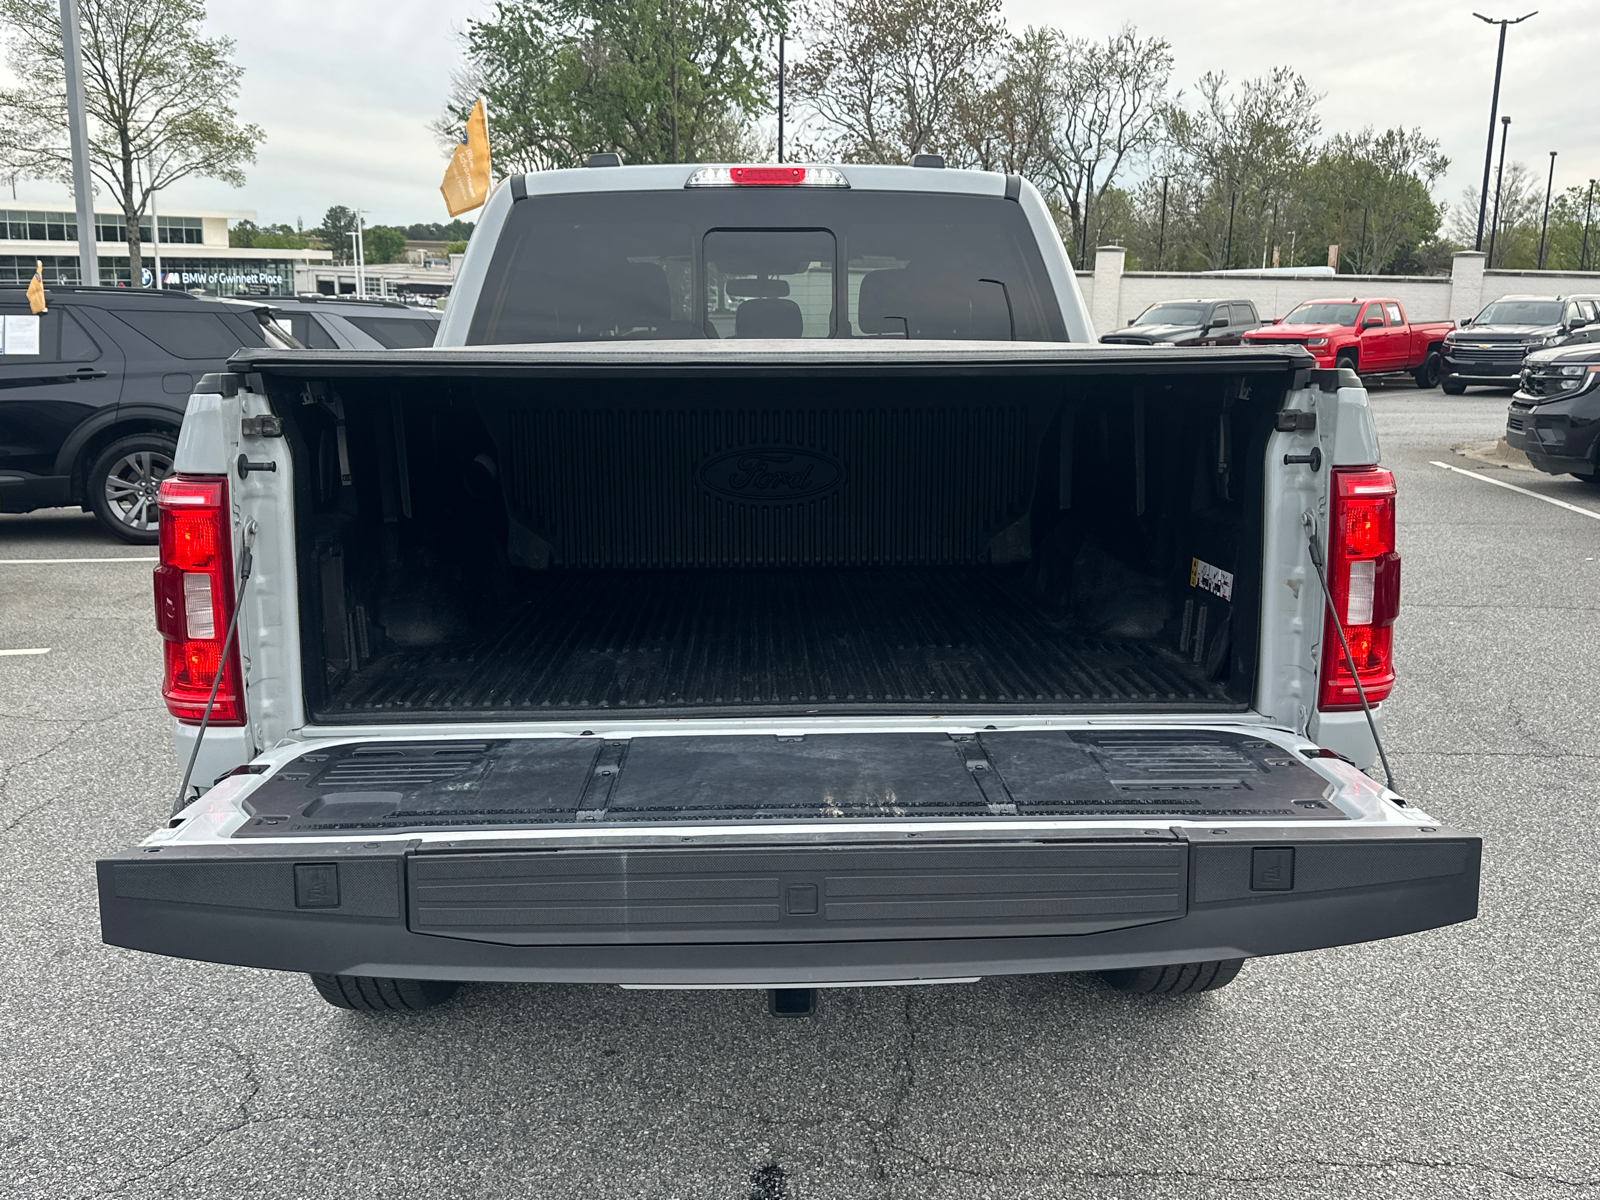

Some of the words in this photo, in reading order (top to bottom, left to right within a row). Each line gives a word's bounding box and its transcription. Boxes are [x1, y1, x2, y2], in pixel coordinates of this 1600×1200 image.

[465, 148, 474, 168] Blue
[458, 153, 476, 198] Advantage
[458, 180, 468, 201] Vehicle
[182, 272, 207, 284] BMW
[208, 272, 218, 284] of
[219, 272, 258, 284] Gwinnett
[259, 272, 283, 284] Place
[729, 454, 814, 490] Ford
